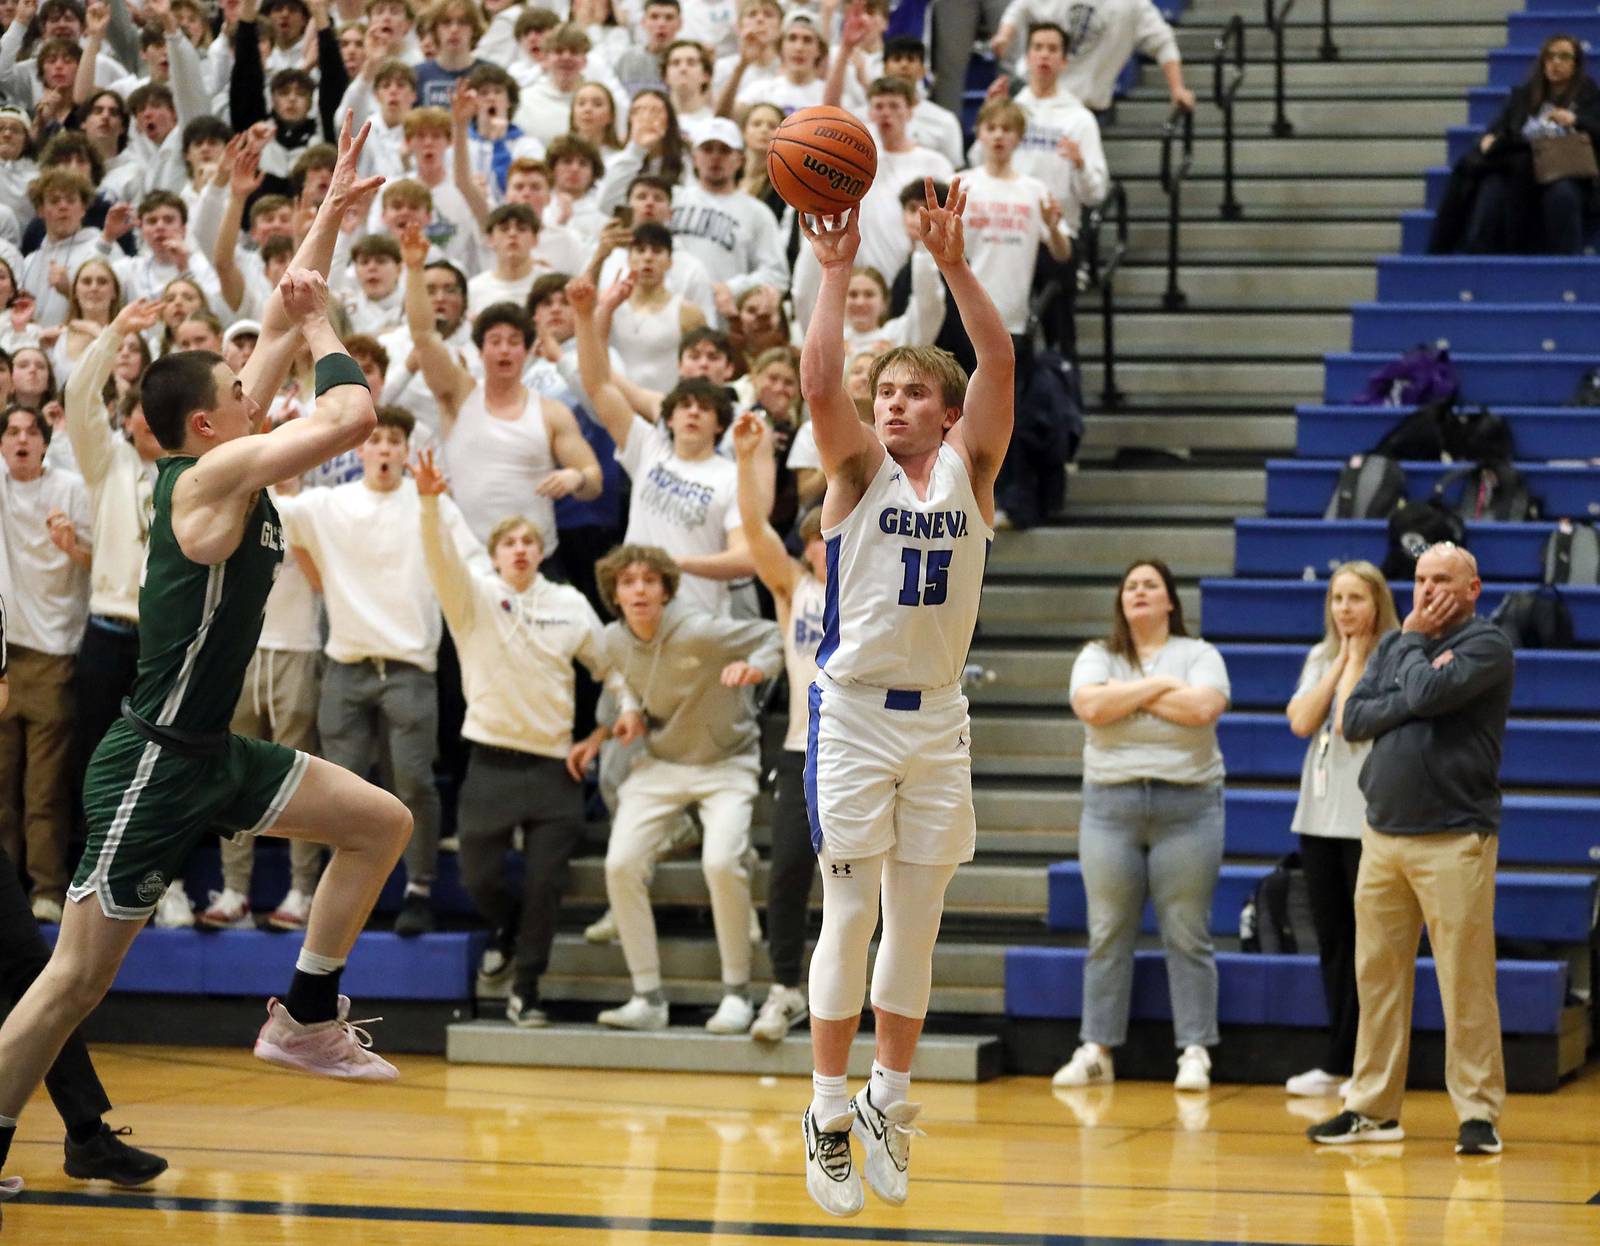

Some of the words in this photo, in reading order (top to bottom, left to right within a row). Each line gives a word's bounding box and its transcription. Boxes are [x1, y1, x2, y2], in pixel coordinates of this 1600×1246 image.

[803, 153, 865, 197] Wilson
[878, 507, 968, 540] GENEVA
[897, 546, 954, 607] 15
